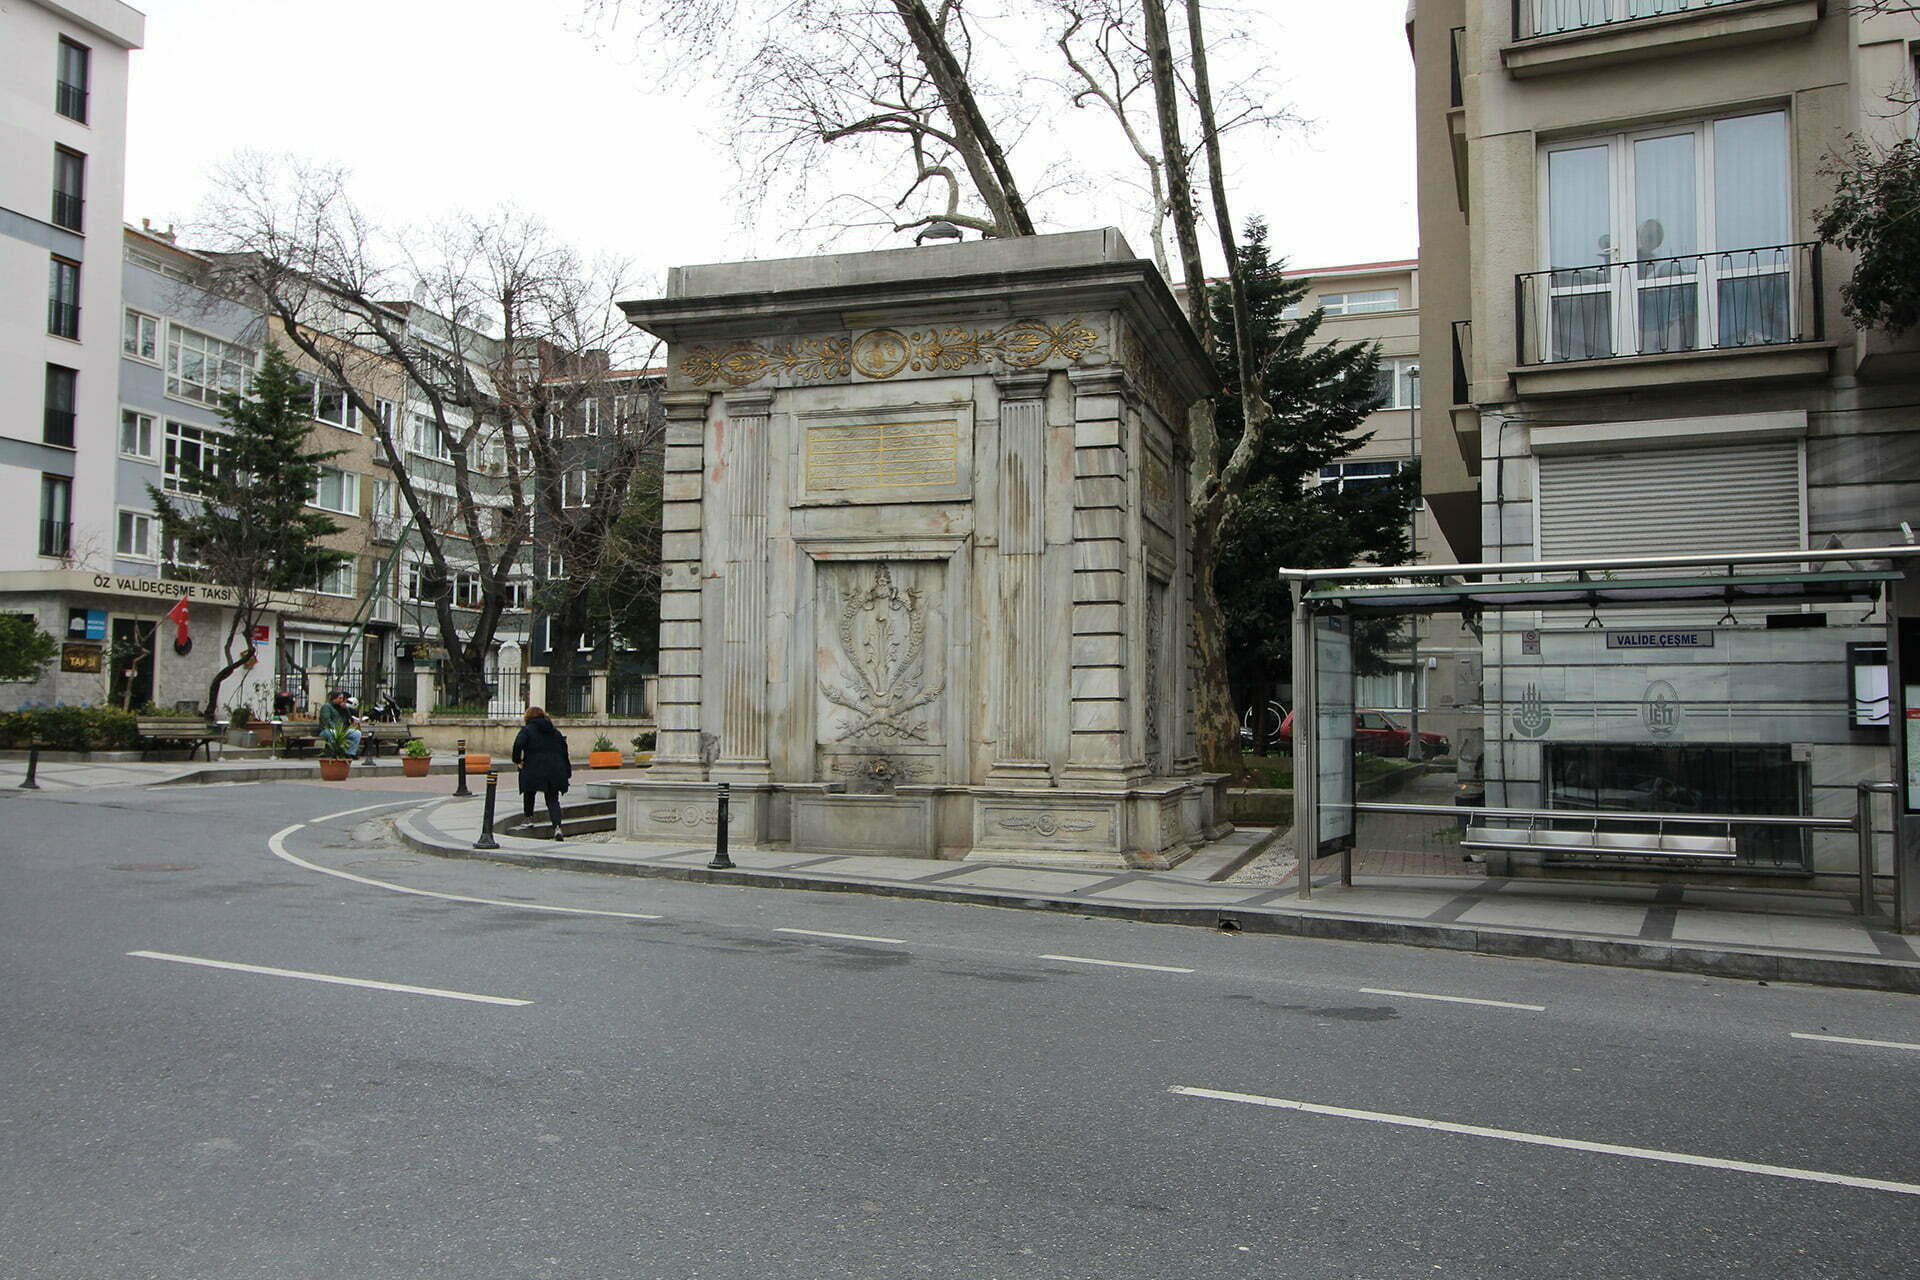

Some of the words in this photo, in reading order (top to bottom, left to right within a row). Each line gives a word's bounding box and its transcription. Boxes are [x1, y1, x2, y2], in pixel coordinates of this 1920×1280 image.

[93, 575, 111, 589] ÖZ
[116, 577, 196, 597] VALİDEÇEŞME
[1616, 632, 1657, 646] VALİDE
[1659, 633, 1698, 647] ÇEŞME
